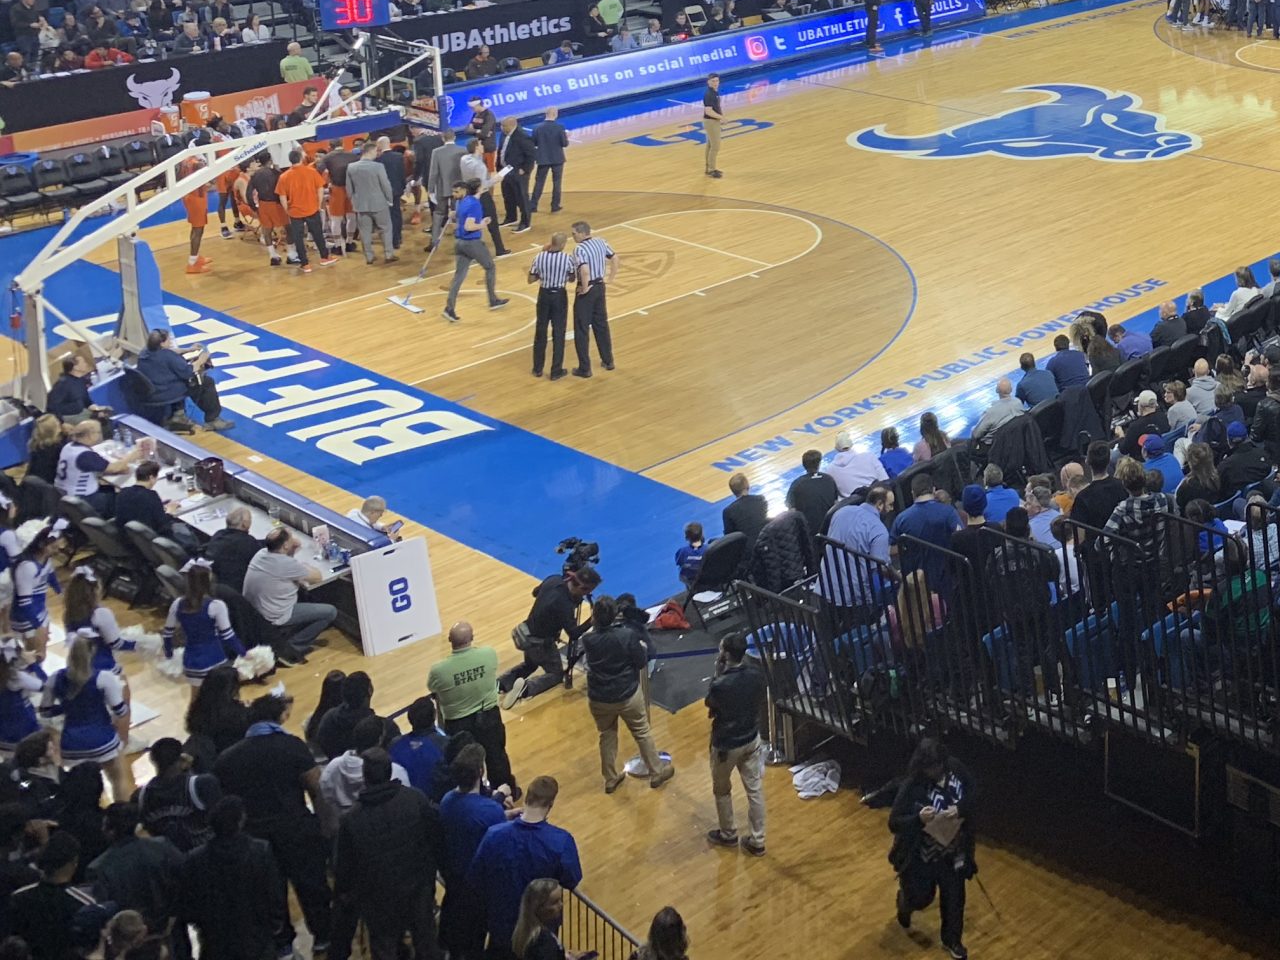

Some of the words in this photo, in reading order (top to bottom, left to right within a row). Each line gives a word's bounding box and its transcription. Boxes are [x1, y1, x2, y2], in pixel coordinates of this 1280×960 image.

[798, 15, 877, 42] UBATHLETI
[482, 90, 528, 108] ollow
[534, 84, 562, 98] the
[568, 72, 609, 90] Bulls
[615, 67, 634, 80] on
[639, 57, 684, 75] social
[689, 46, 738, 66] media!
[710, 435, 794, 473] NEW
[792, 387, 908, 435] YORK'S
[905, 346, 1007, 390] PUBLIC
[1002, 276, 1169, 347] POWERHOUSE
[388, 577, 412, 613] GO
[453, 665, 485, 681] EVENT
[455, 672, 486, 687] STAFF
